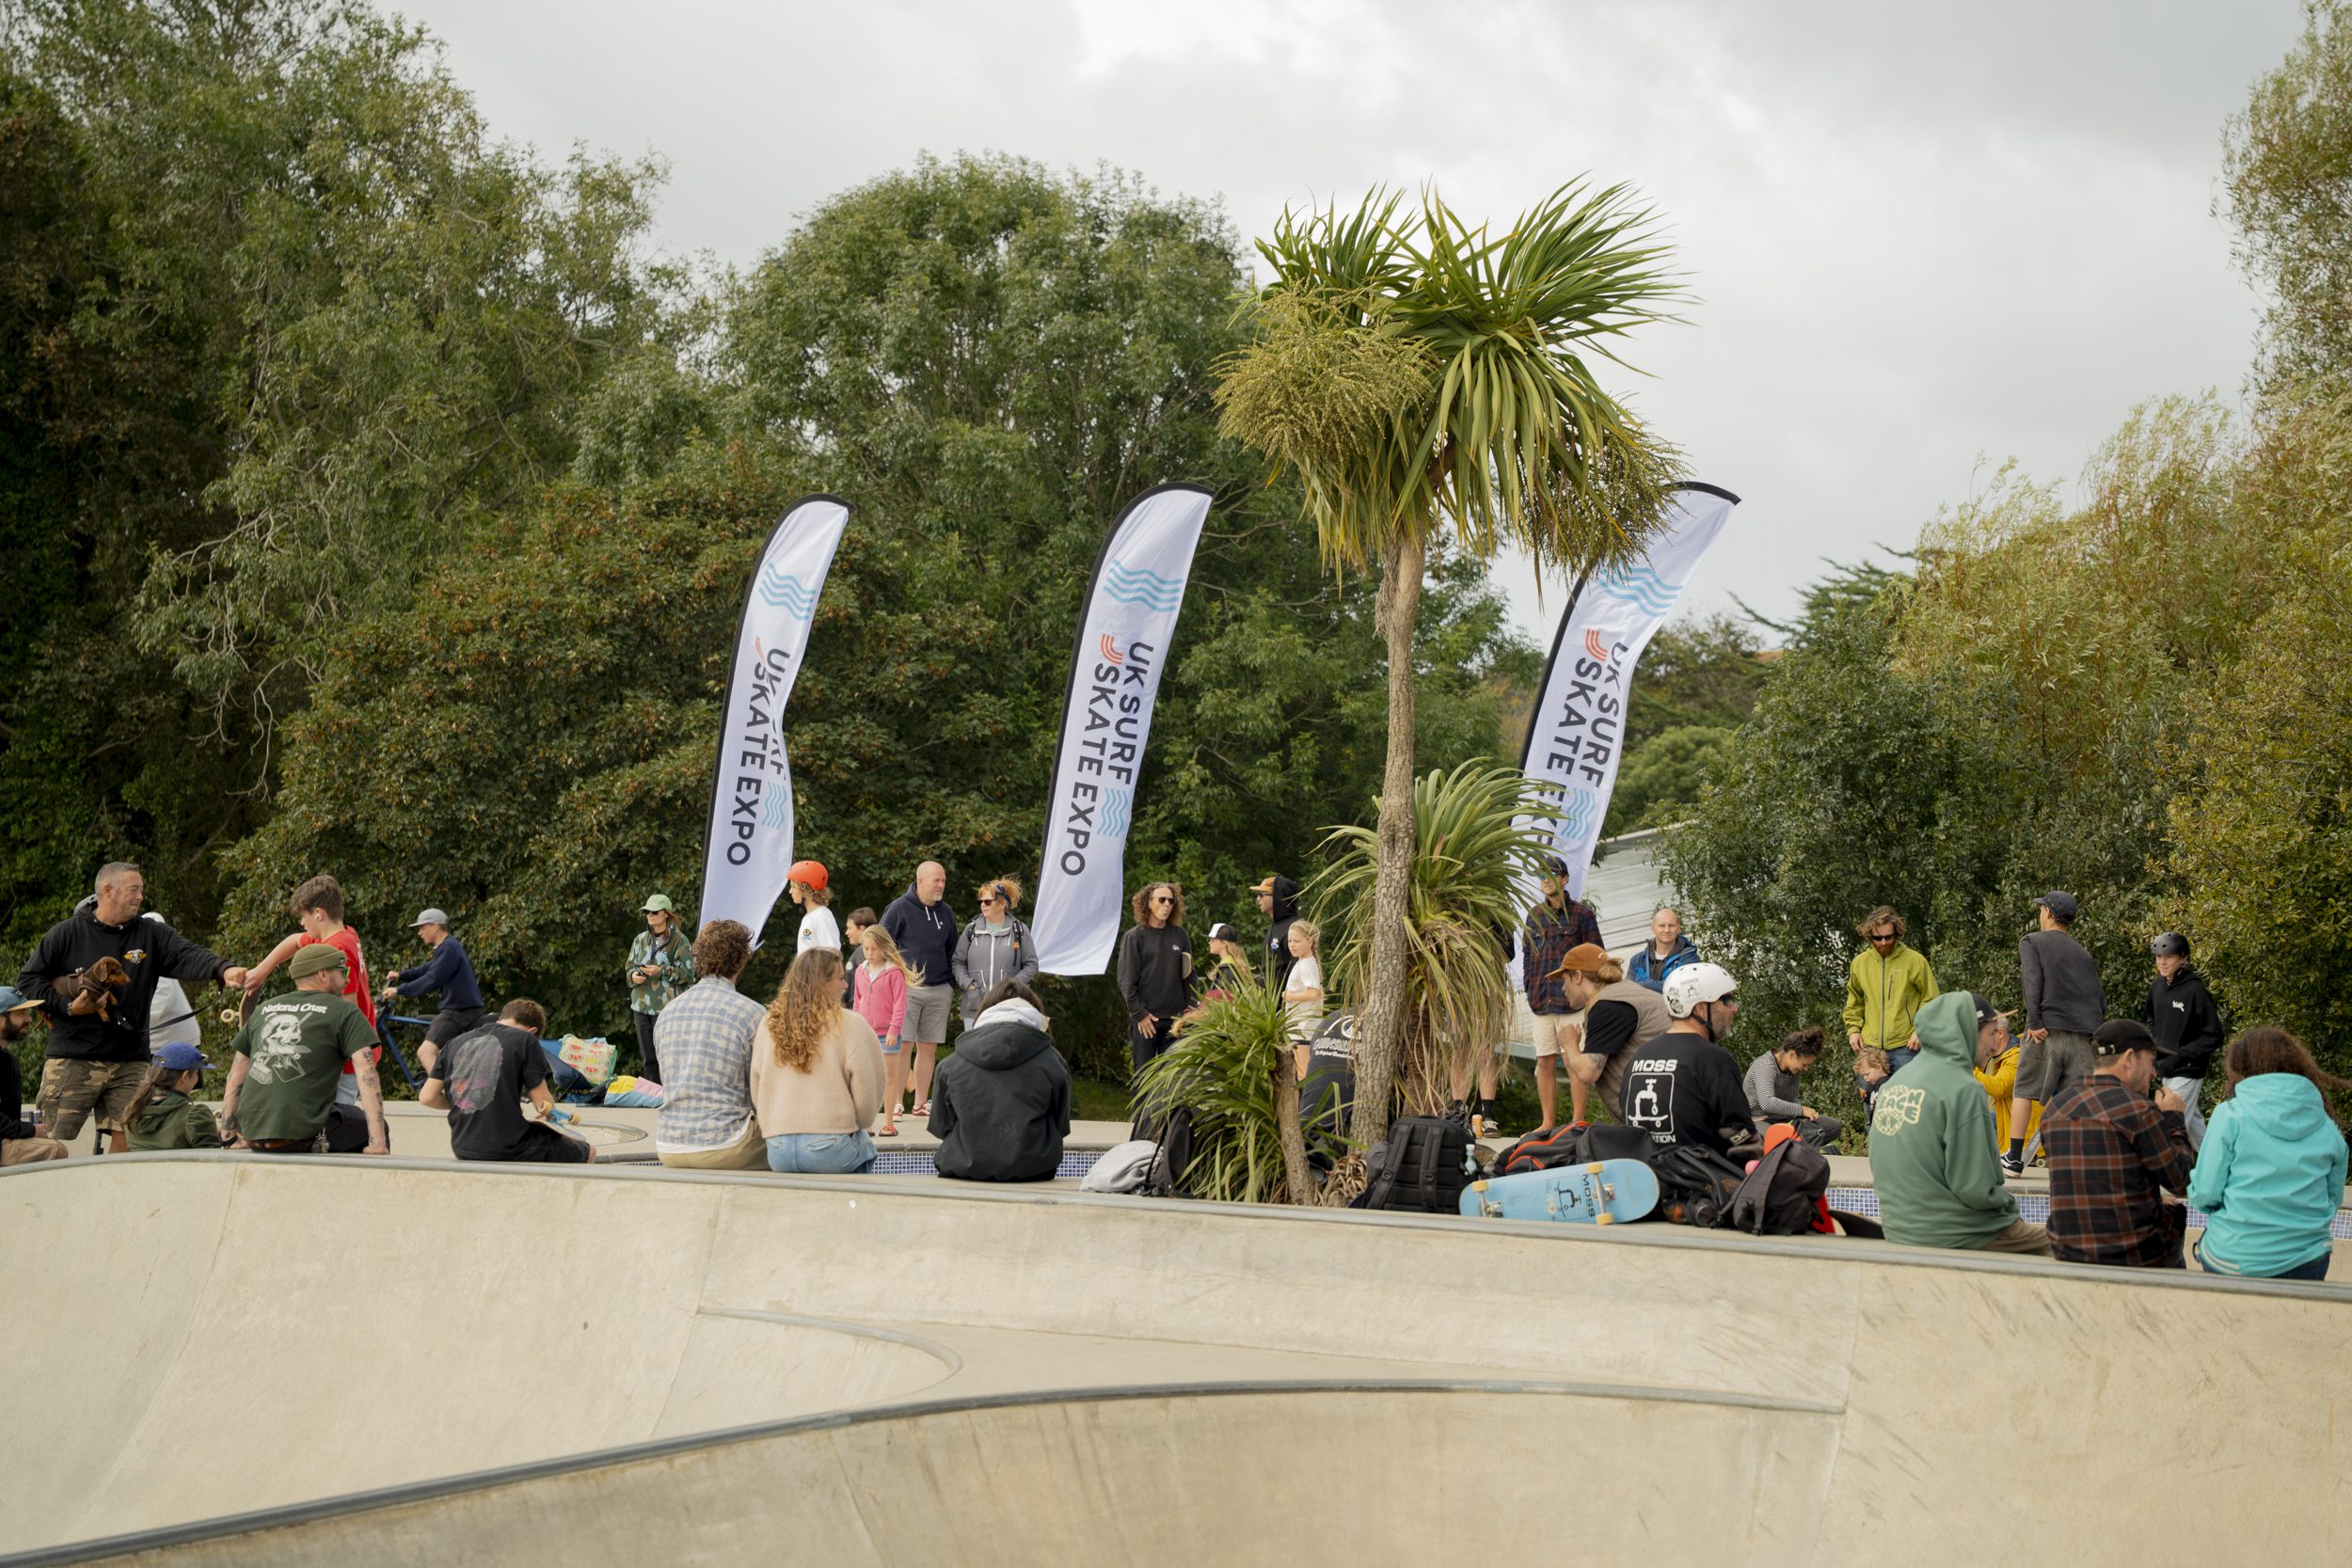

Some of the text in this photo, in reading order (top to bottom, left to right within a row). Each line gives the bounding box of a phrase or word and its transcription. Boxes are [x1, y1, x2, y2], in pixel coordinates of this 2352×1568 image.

[727, 661, 771, 865] SKATE EXPO
[1060, 662, 1120, 876] SKATE EXPO
[1108, 641, 1153, 784] UK SURF
[1547, 657, 1602, 775] SKATE
[1580, 641, 1629, 788] UK SURF
[262, 1002, 300, 1015] National
[1632, 1059, 1677, 1072] MOSS
[1582, 1174, 1596, 1217] MOSS
